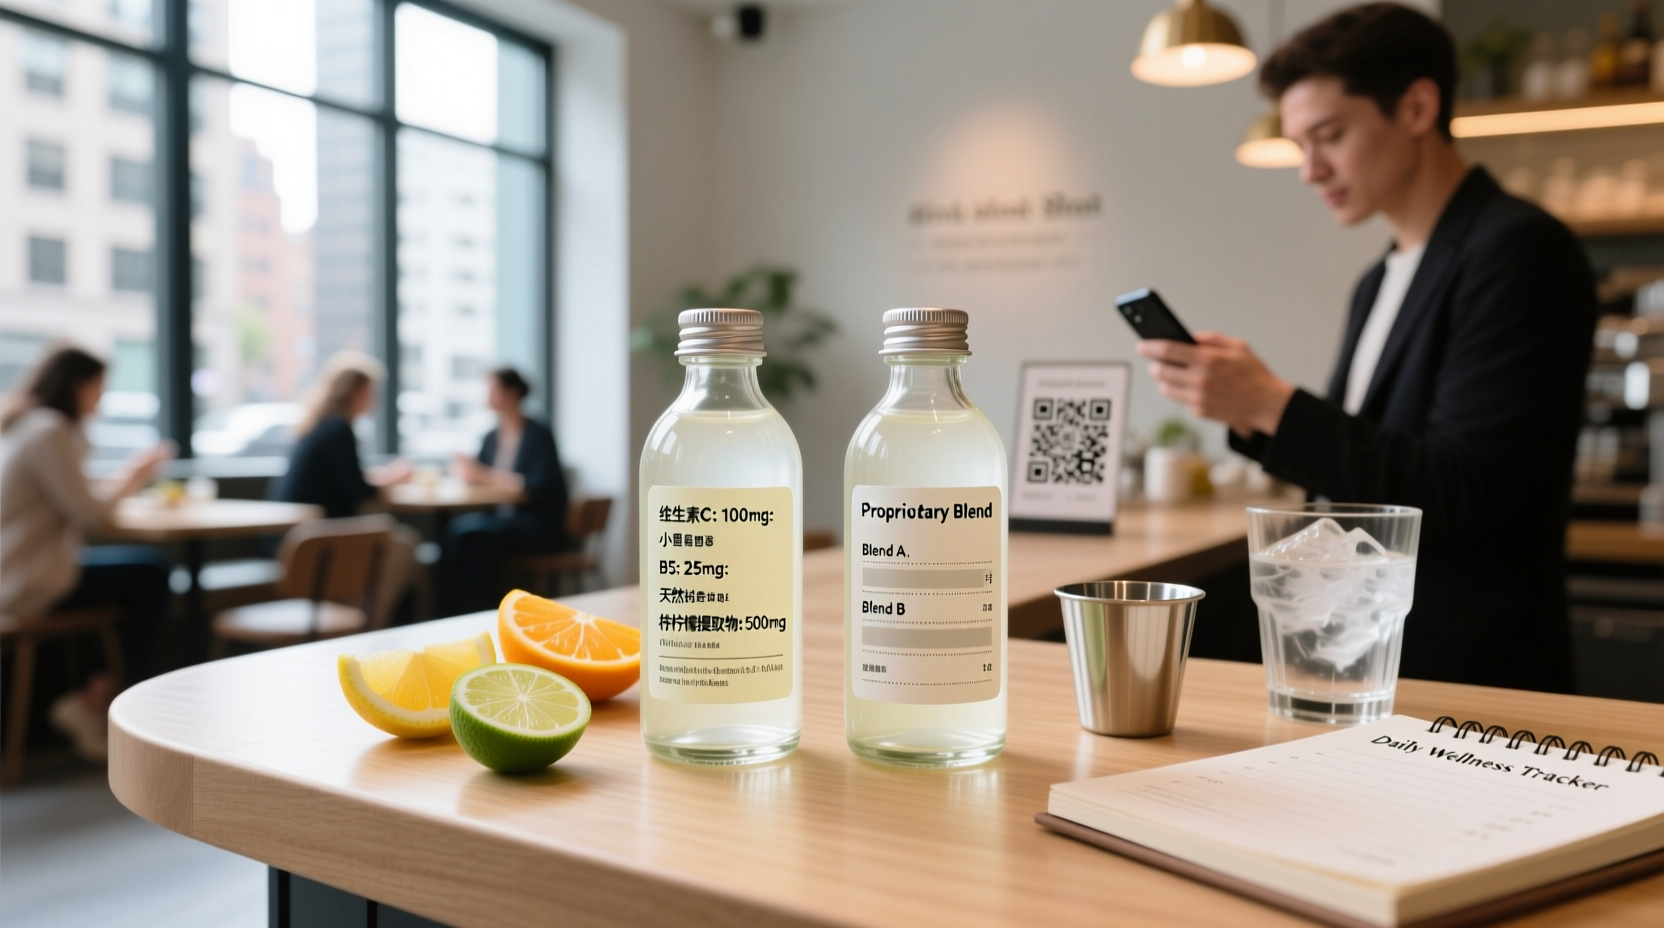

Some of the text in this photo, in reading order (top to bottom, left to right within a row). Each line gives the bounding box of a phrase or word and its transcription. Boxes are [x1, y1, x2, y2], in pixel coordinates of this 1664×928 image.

[721, 506, 775, 527] 100mg:
[953, 501, 993, 520] Blend
[861, 542, 894, 558] Blend
[683, 559, 730, 581] 25mg:
[861, 600, 907, 617] Blend B
[1370, 734, 1611, 792] Daily Wellness Tracker
